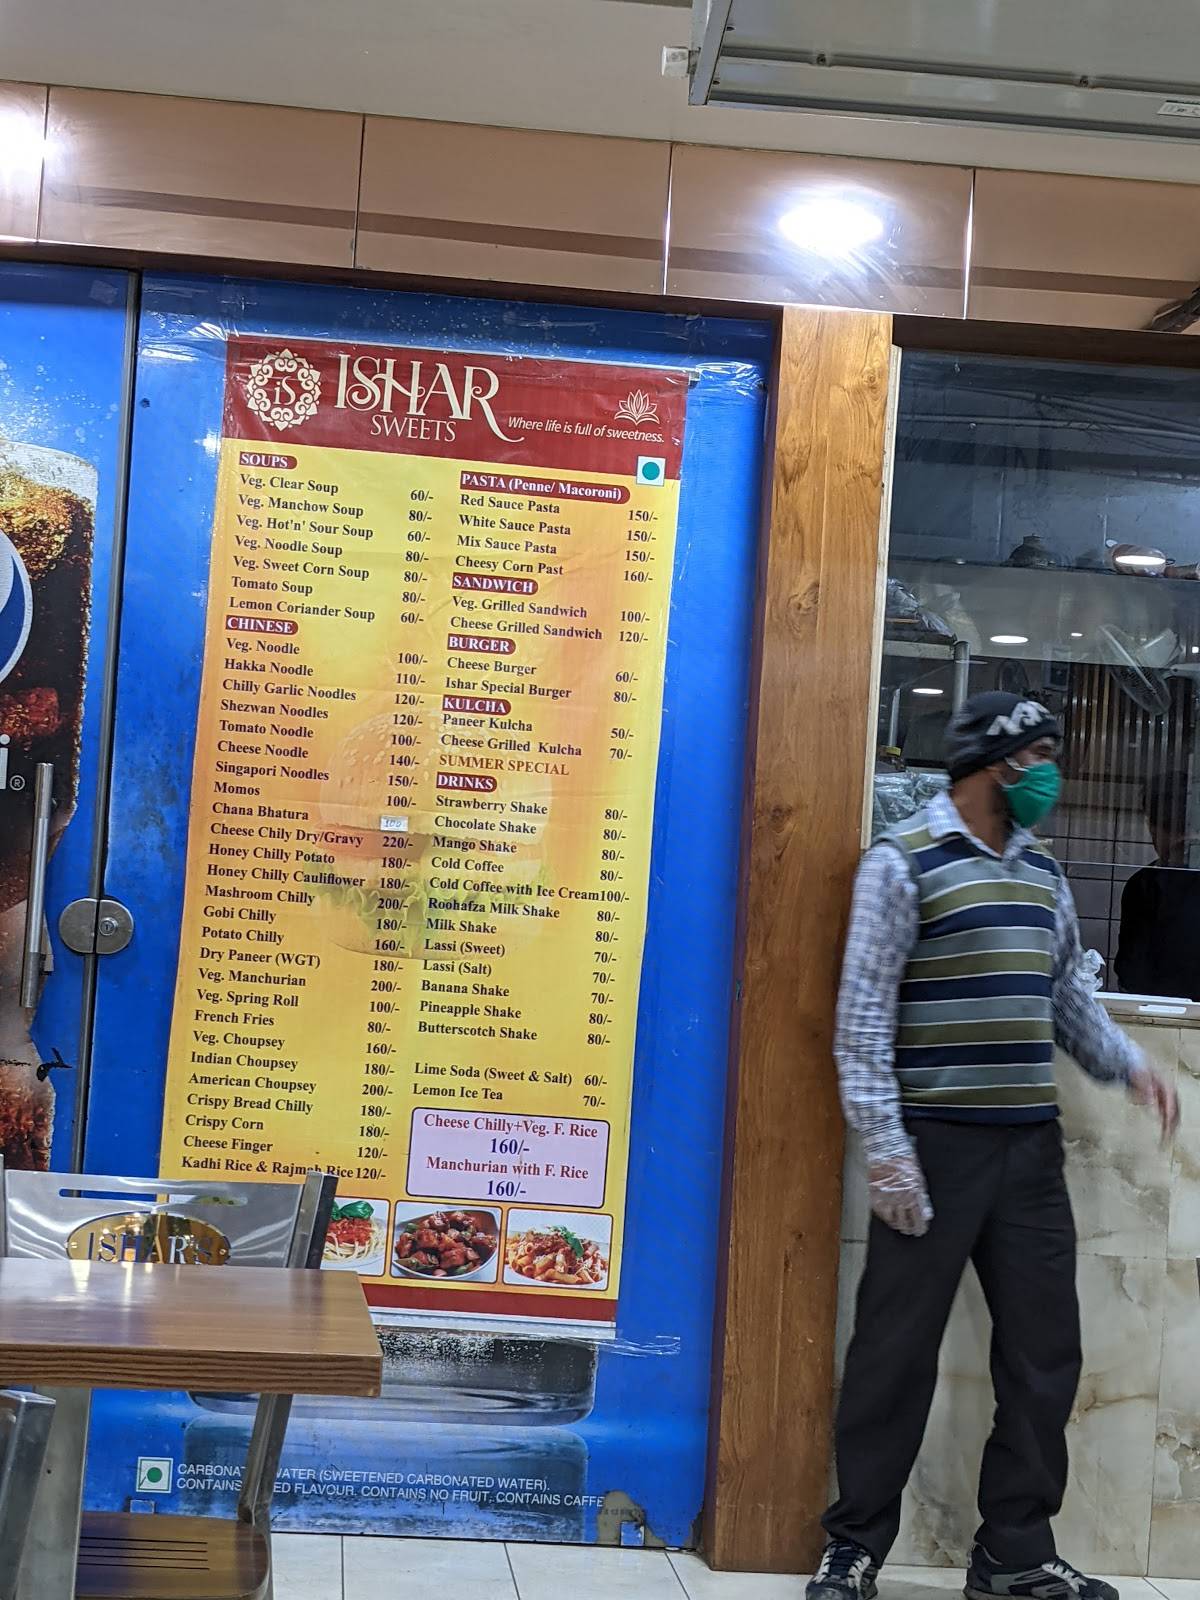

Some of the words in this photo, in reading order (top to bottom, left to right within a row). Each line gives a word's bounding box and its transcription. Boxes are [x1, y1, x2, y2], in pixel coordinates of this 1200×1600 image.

[334, 354, 525, 442] ISHAR
[370, 414, 456, 442] SWEETS
[508, 416, 543, 431] Where
[545, 419, 562, 433] life
[563, 422, 573, 434] is
[574, 422, 593, 436] full
[594, 425, 606, 437] of
[607, 428, 665, 443] sweetness.
[240, 453, 288, 468] SOUPS
[239, 473, 266, 490] Veg.
[269, 475, 305, 490] Clear
[306, 479, 339, 497] Soup
[409, 489, 434, 502] 60/-
[461, 473, 506, 489] PASTA
[558, 483, 622, 501] Macoroni)
[237, 493, 264, 510] Veg.
[267, 496, 330, 513] Manchow
[331, 502, 364, 520] Soup
[408, 509, 433, 522] 80/-
[459, 493, 485, 507] Red
[487, 495, 524, 511] Sauce
[527, 499, 560, 514] Pasta
[628, 509, 659, 522] 150/-
[458, 513, 496, 529] White
[498, 517, 535, 532] Sauce
[538, 521, 571, 536] Pasta
[626, 529, 657, 543] 150/-
[234, 534, 261, 551] Veg.
[263, 537, 309, 553] Noodle
[310, 541, 343, 559] Soup
[404, 550, 430, 563] 80/-
[232, 554, 259, 572] Veg.
[262, 557, 300, 573] Sweet
[302, 561, 334, 576] Corn
[337, 564, 370, 582] Soup
[403, 570, 428, 584] 80/-
[454, 554, 499, 573] Cheesy
[502, 559, 534, 573] Corn
[536, 561, 564, 576] Past
[623, 569, 654, 583] 160/-
[453, 575, 535, 594] SANDWICH
[228, 595, 273, 612] Lemon
[276, 600, 342, 617] Coriander
[343, 606, 376, 623] Soup
[400, 611, 425, 624] 60/-
[227, 617, 293, 634] CHINESE
[449, 615, 494, 631] Cheese
[496, 619, 540, 635] Grilled
[542, 623, 603, 640] Sandwich
[619, 630, 649, 644] 120/-
[448, 636, 510, 653] BURGER
[222, 678, 261, 696] Chilly
[263, 681, 304, 697] Garlic
[306, 685, 357, 701] Noodles
[394, 693, 425, 706] 120/-
[445, 676, 479, 691] Ishar
[480, 679, 525, 695] Special
[528, 683, 573, 701] Burger
[612, 690, 637, 703] 80/-
[443, 698, 507, 714] KULCHA
[218, 719, 267, 734] Tomato
[269, 723, 314, 738] Noodle
[391, 733, 422, 747] 100/-
[440, 733, 485, 748] Cheese
[486, 737, 531, 752] Grilled
[537, 741, 582, 756] Kulcha
[609, 747, 633, 760] 70/-
[214, 760, 277, 778] Singapori
[279, 765, 330, 781] Noodles
[388, 774, 419, 788] 150/-
[438, 753, 505, 770] SUMMER
[507, 759, 570, 775] SPECIAL
[437, 775, 494, 790] DRINKS
[435, 794, 507, 815] Strawberry
[509, 800, 548, 815] Shake
[604, 808, 628, 821] 80/-
[432, 835, 477, 853] Mango
[478, 839, 517, 854] Shake
[601, 848, 625, 862] 80/-
[206, 863, 248, 881] Honey
[250, 866, 290, 884] Chilly
[292, 870, 366, 888] Cauliflower
[379, 876, 411, 890] 180/-
[430, 855, 461, 870] Cold
[463, 858, 505, 873] Coffee
[599, 869, 624, 882] 80/-
[202, 904, 235, 919] Gobi
[237, 907, 277, 925] Chilly
[375, 917, 407, 932] 180/-
[428, 898, 486, 913] Roohafza
[490, 902, 519, 915] Milk
[523, 906, 561, 919] Shake
[596, 910, 620, 923] 80/-
[199, 946, 225, 963] Dry
[227, 948, 273, 964] Paneer
[274, 952, 321, 970] (WGT)
[373, 959, 404, 973] 180/-
[423, 938, 457, 952] Lassi
[459, 940, 506, 958] (Sweet)
[593, 950, 617, 964] 70/-
[195, 987, 223, 1005] Veg.
[225, 990, 270, 1008] Spring
[272, 993, 299, 1007] Roll
[369, 1000, 400, 1014] 100/-
[420, 979, 469, 994] Banana
[471, 982, 510, 997] Shake
[590, 991, 614, 1005] 70/-
[192, 1029, 220, 1047] Veg.
[222, 1032, 286, 1051] Choupsey
[365, 1042, 397, 1056] 160/-
[417, 1020, 496, 1038] Butterscotch
[499, 1026, 538, 1041] Shake
[586, 1032, 611, 1046] 80/-
[187, 1072, 251, 1088] American
[254, 1076, 317, 1095] Choupsey
[361, 1083, 393, 1097] 200/-
[413, 1061, 447, 1076] Lime
[449, 1064, 481, 1078] Soda
[483, 1066, 525, 1081] (Sweet
[527, 1070, 540, 1082] &
[542, 1070, 573, 1087] Salt)
[583, 1074, 608, 1087] 60/-
[423, 1113, 470, 1129] Cheese
[553, 1121, 565, 1136] F.
[568, 1122, 598, 1138] Rice
[183, 1134, 228, 1149] Cheese
[230, 1137, 274, 1155] Finger
[356, 1146, 388, 1159] 120/-
[491, 1137, 530, 1156] 160/-
[425, 1155, 508, 1174] Manchurian
[511, 1162, 541, 1176] with
[544, 1163, 556, 1177] F.
[559, 1164, 589, 1180] Rice
[487, 1179, 527, 1197] 160/-
[294, 1482, 358, 1497] FLAVOUR.
[361, 1485, 426, 1500] CONTAINS
[430, 1488, 449, 1500] NO
[496, 1491, 561, 1506] CONTAINS
[319, 1469, 403, 1485] (SWEETENED
[407, 1473, 494, 1488] CARBONATED
[498, 1477, 551, 1492] WATER).
